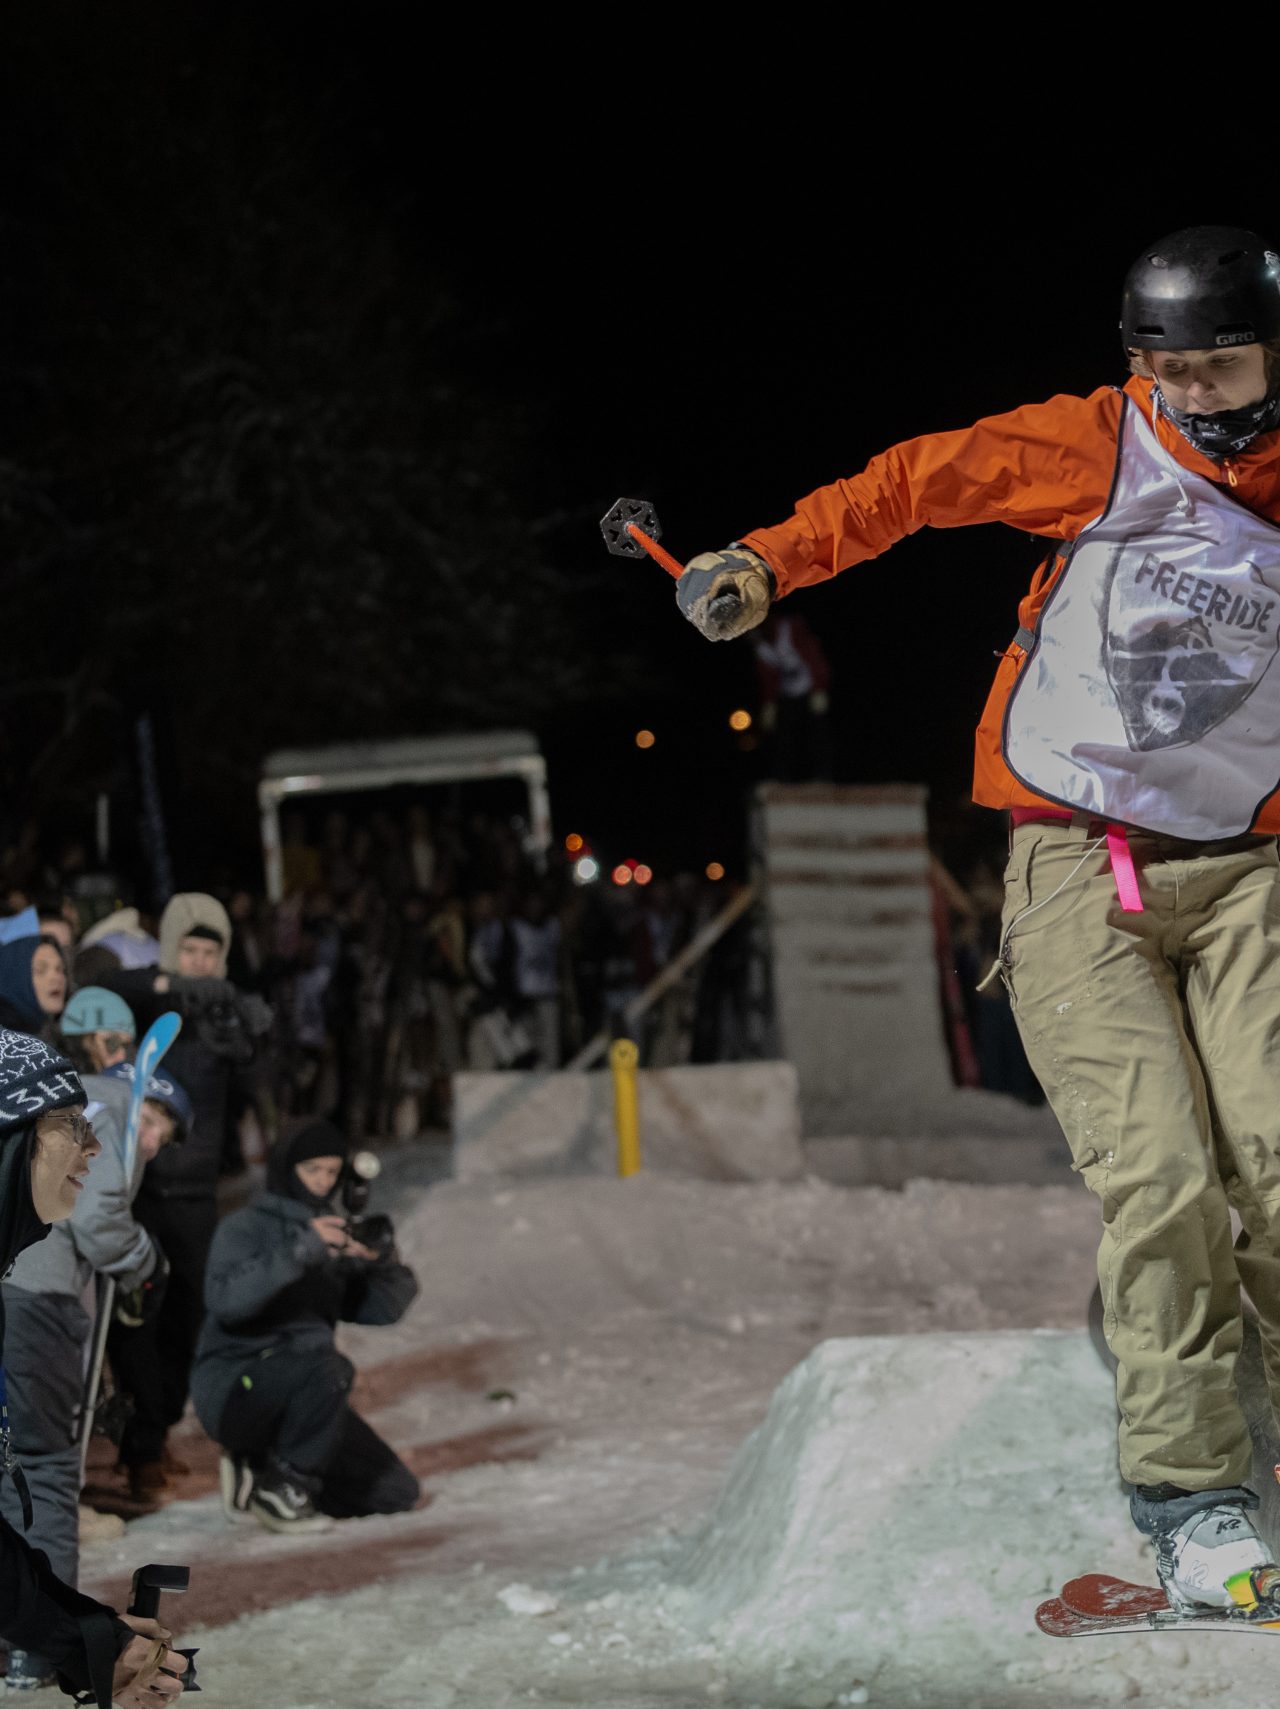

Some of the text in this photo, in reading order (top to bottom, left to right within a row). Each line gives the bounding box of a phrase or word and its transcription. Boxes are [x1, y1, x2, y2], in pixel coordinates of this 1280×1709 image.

[1216, 331, 1255, 346] GIRO
[1134, 552, 1275, 633] FREERIDE
[1216, 1518, 1242, 1535] K2
